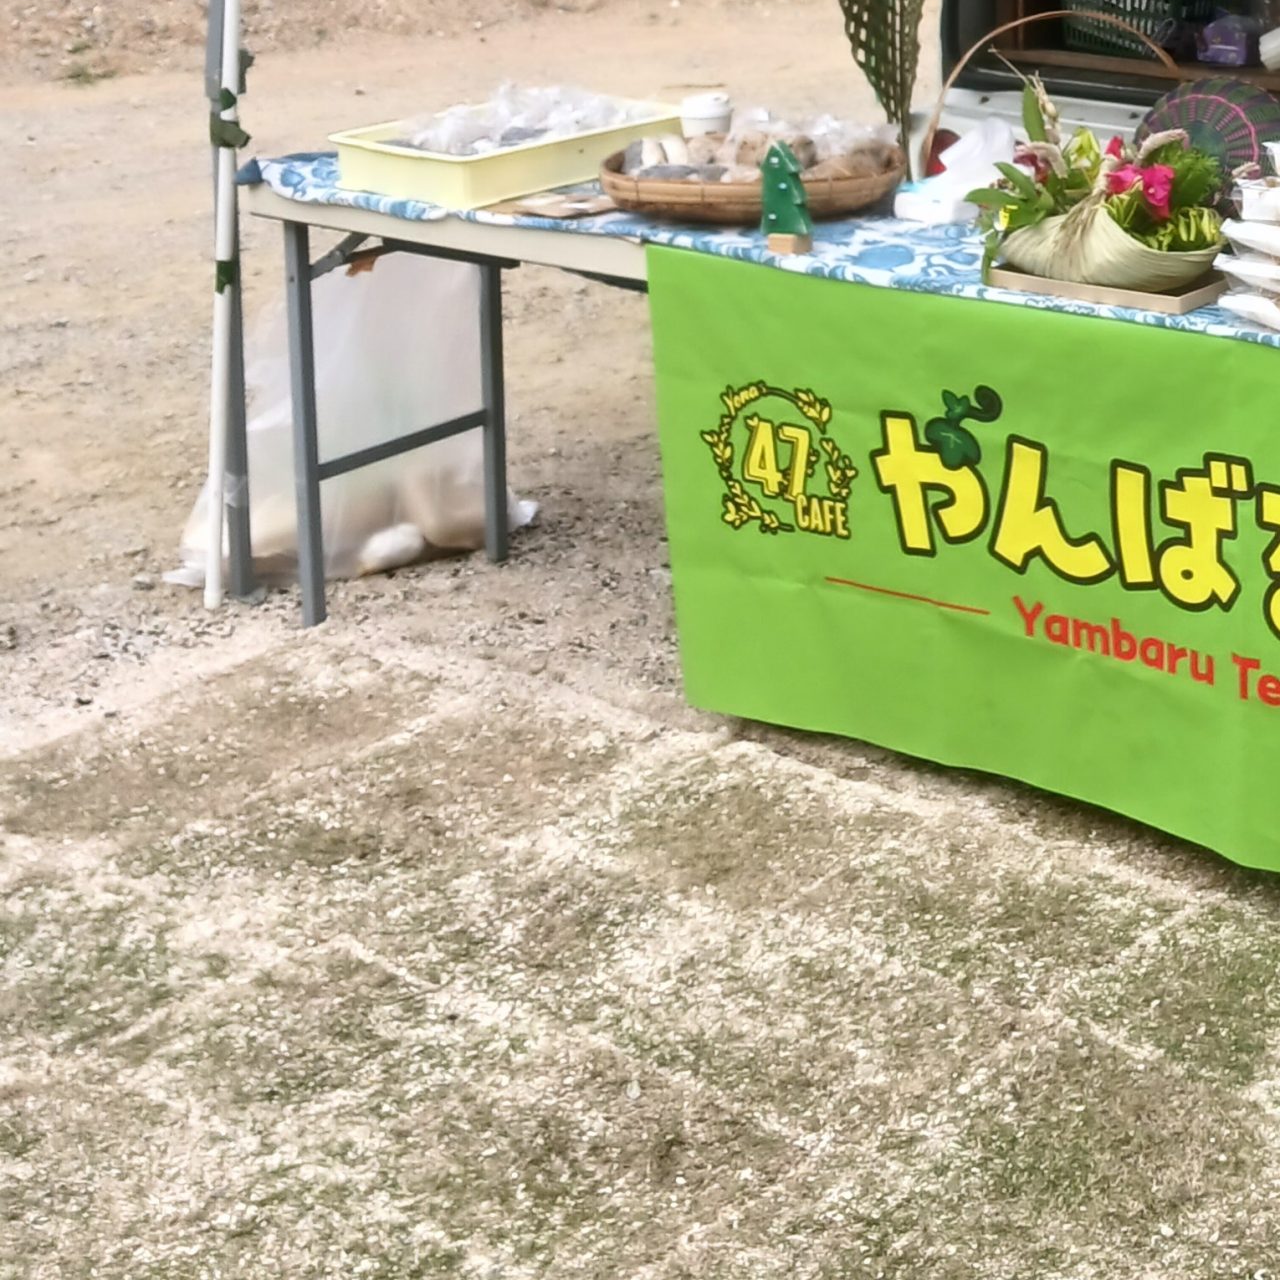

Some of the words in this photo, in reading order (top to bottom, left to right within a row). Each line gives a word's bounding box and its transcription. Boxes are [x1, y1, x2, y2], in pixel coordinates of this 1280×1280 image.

[744, 413, 812, 501] 47
[794, 494, 851, 540] CAFE
[1012, 596, 1216, 687] Yambaru
